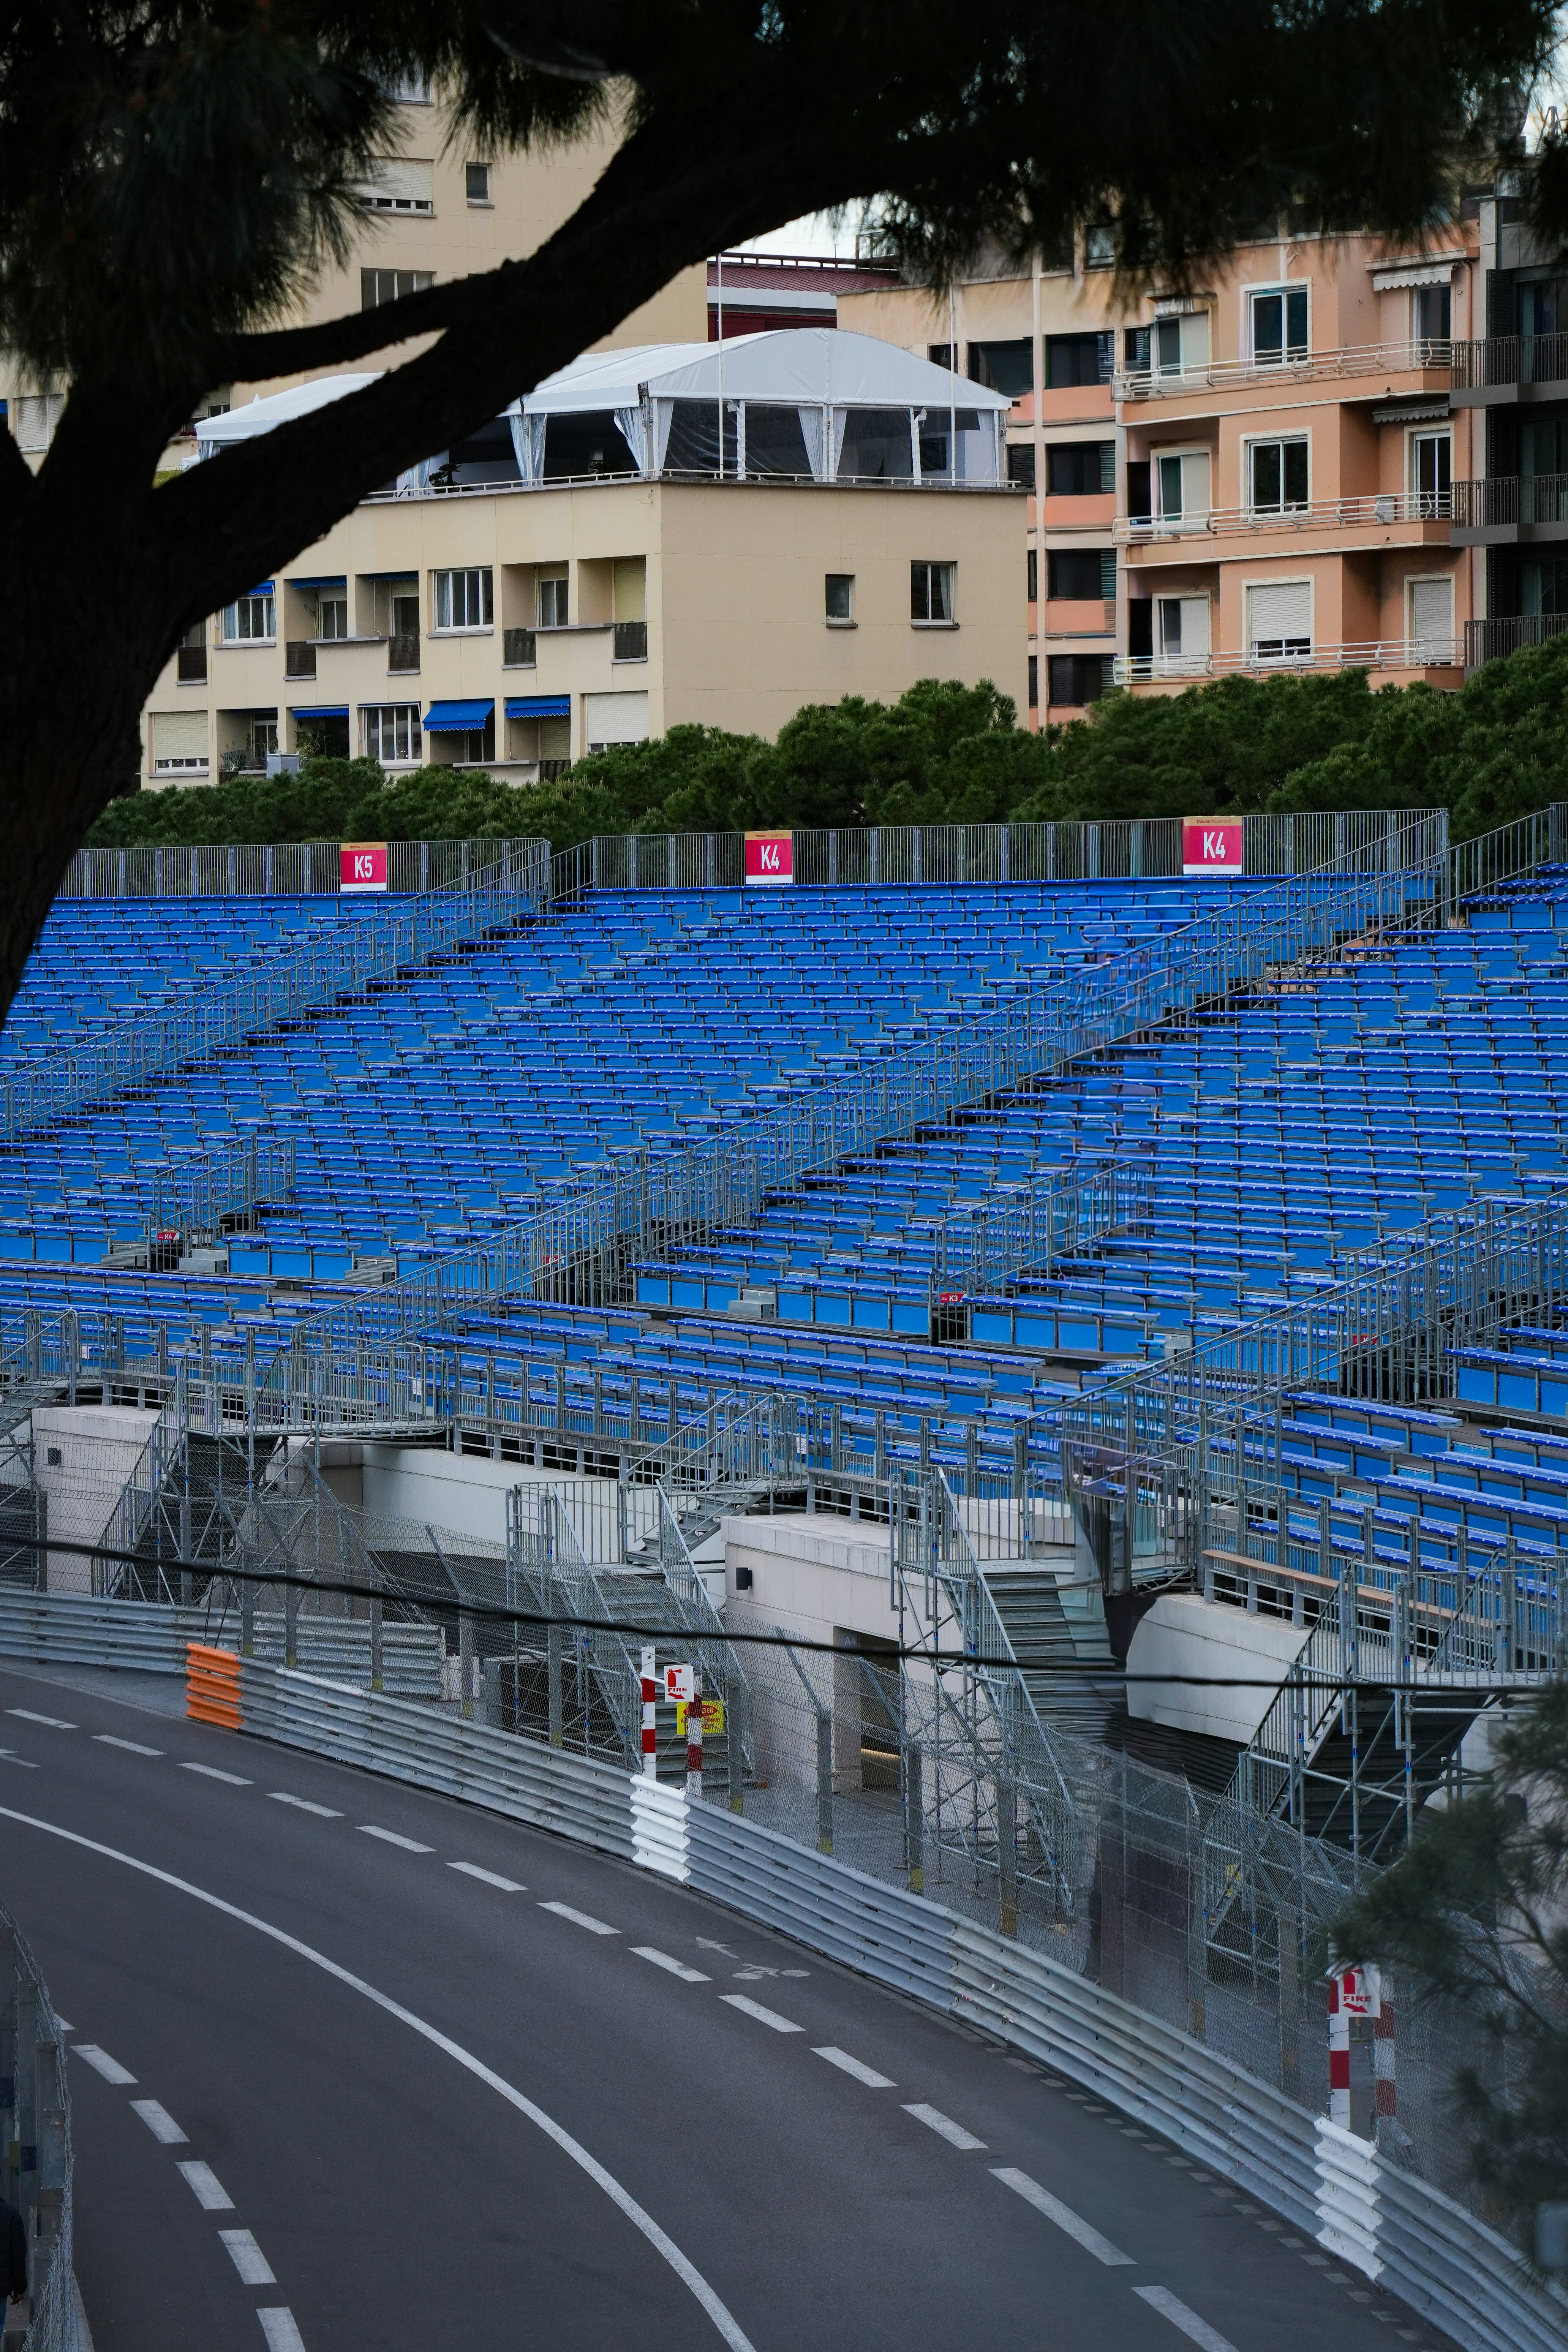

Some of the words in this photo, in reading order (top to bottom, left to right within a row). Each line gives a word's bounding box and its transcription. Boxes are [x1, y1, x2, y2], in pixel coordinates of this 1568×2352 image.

[1203, 832, 1226, 858] K4
[355, 855, 373, 878] K5
[761, 845, 780, 869] K4
[844, 1637, 856, 1645] A4
